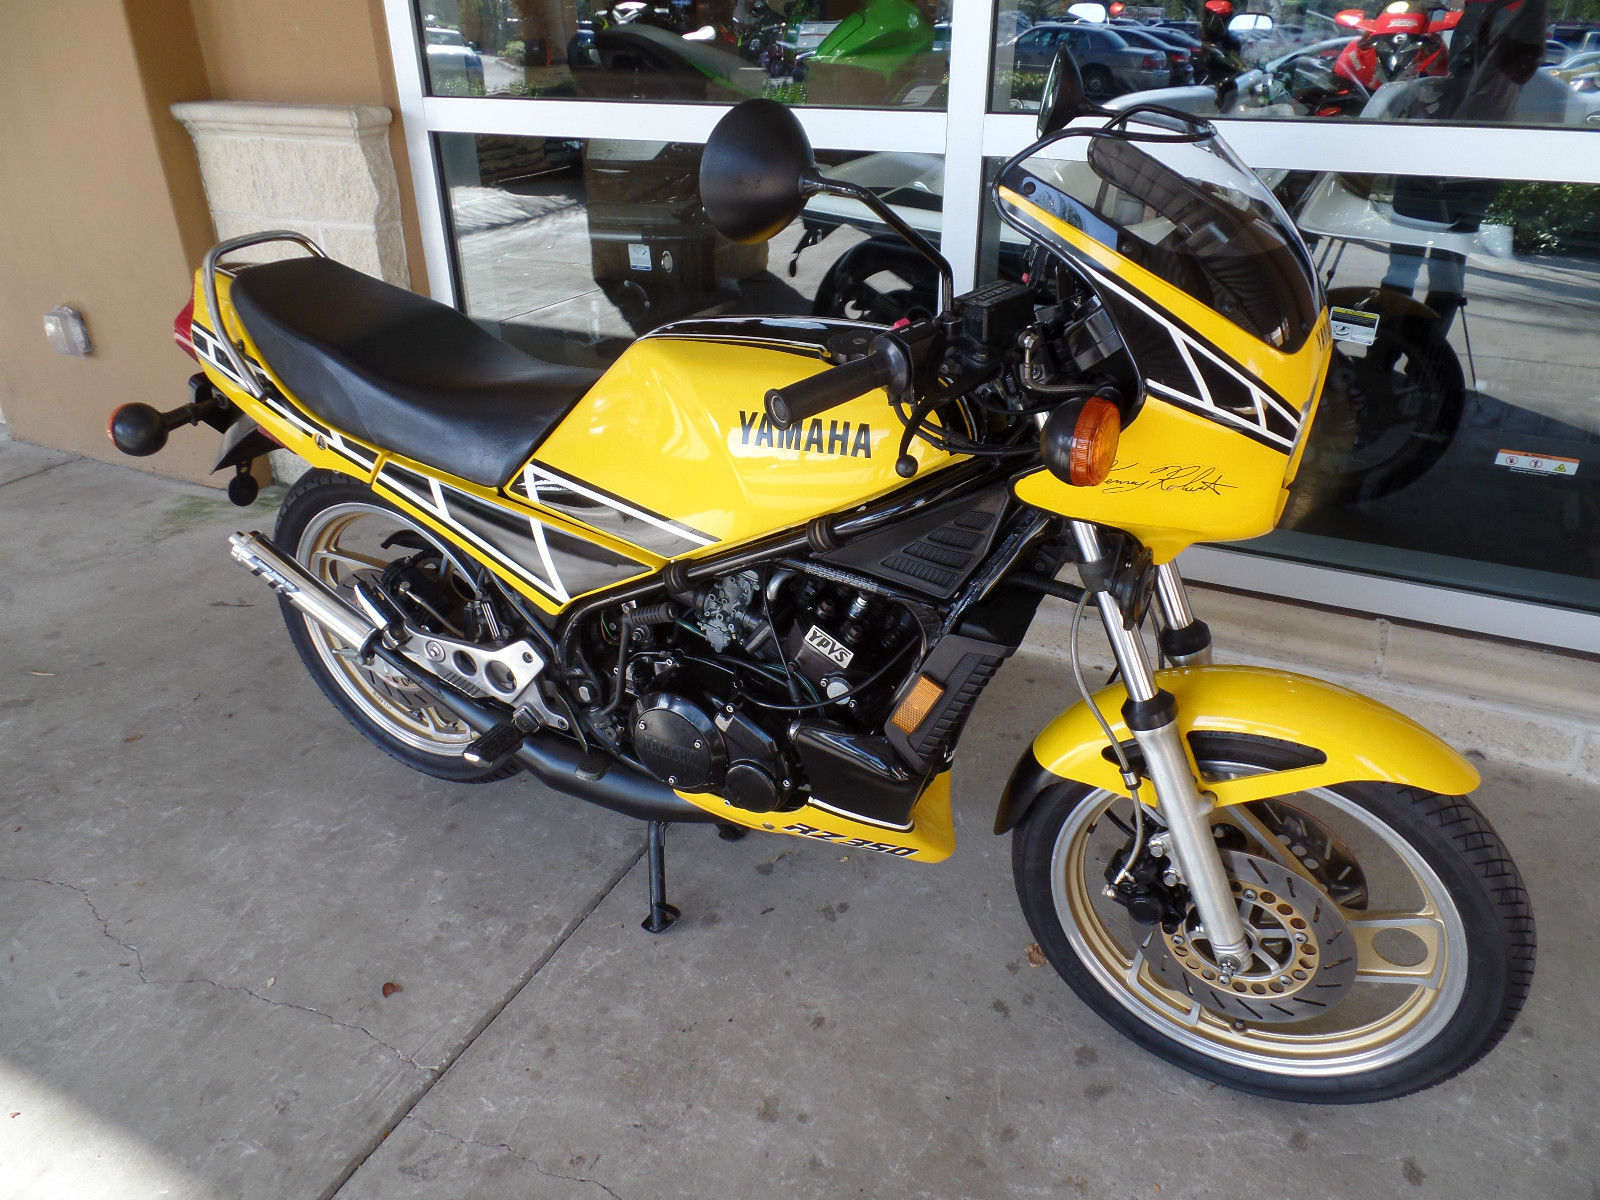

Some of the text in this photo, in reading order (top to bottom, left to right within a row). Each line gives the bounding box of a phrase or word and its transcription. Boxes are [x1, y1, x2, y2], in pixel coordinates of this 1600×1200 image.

[739, 410, 872, 459] YAMAHA
[1102, 460, 1149, 494] enny
[808, 627, 851, 662] YPVS
[782, 823, 920, 858] RZ 350
